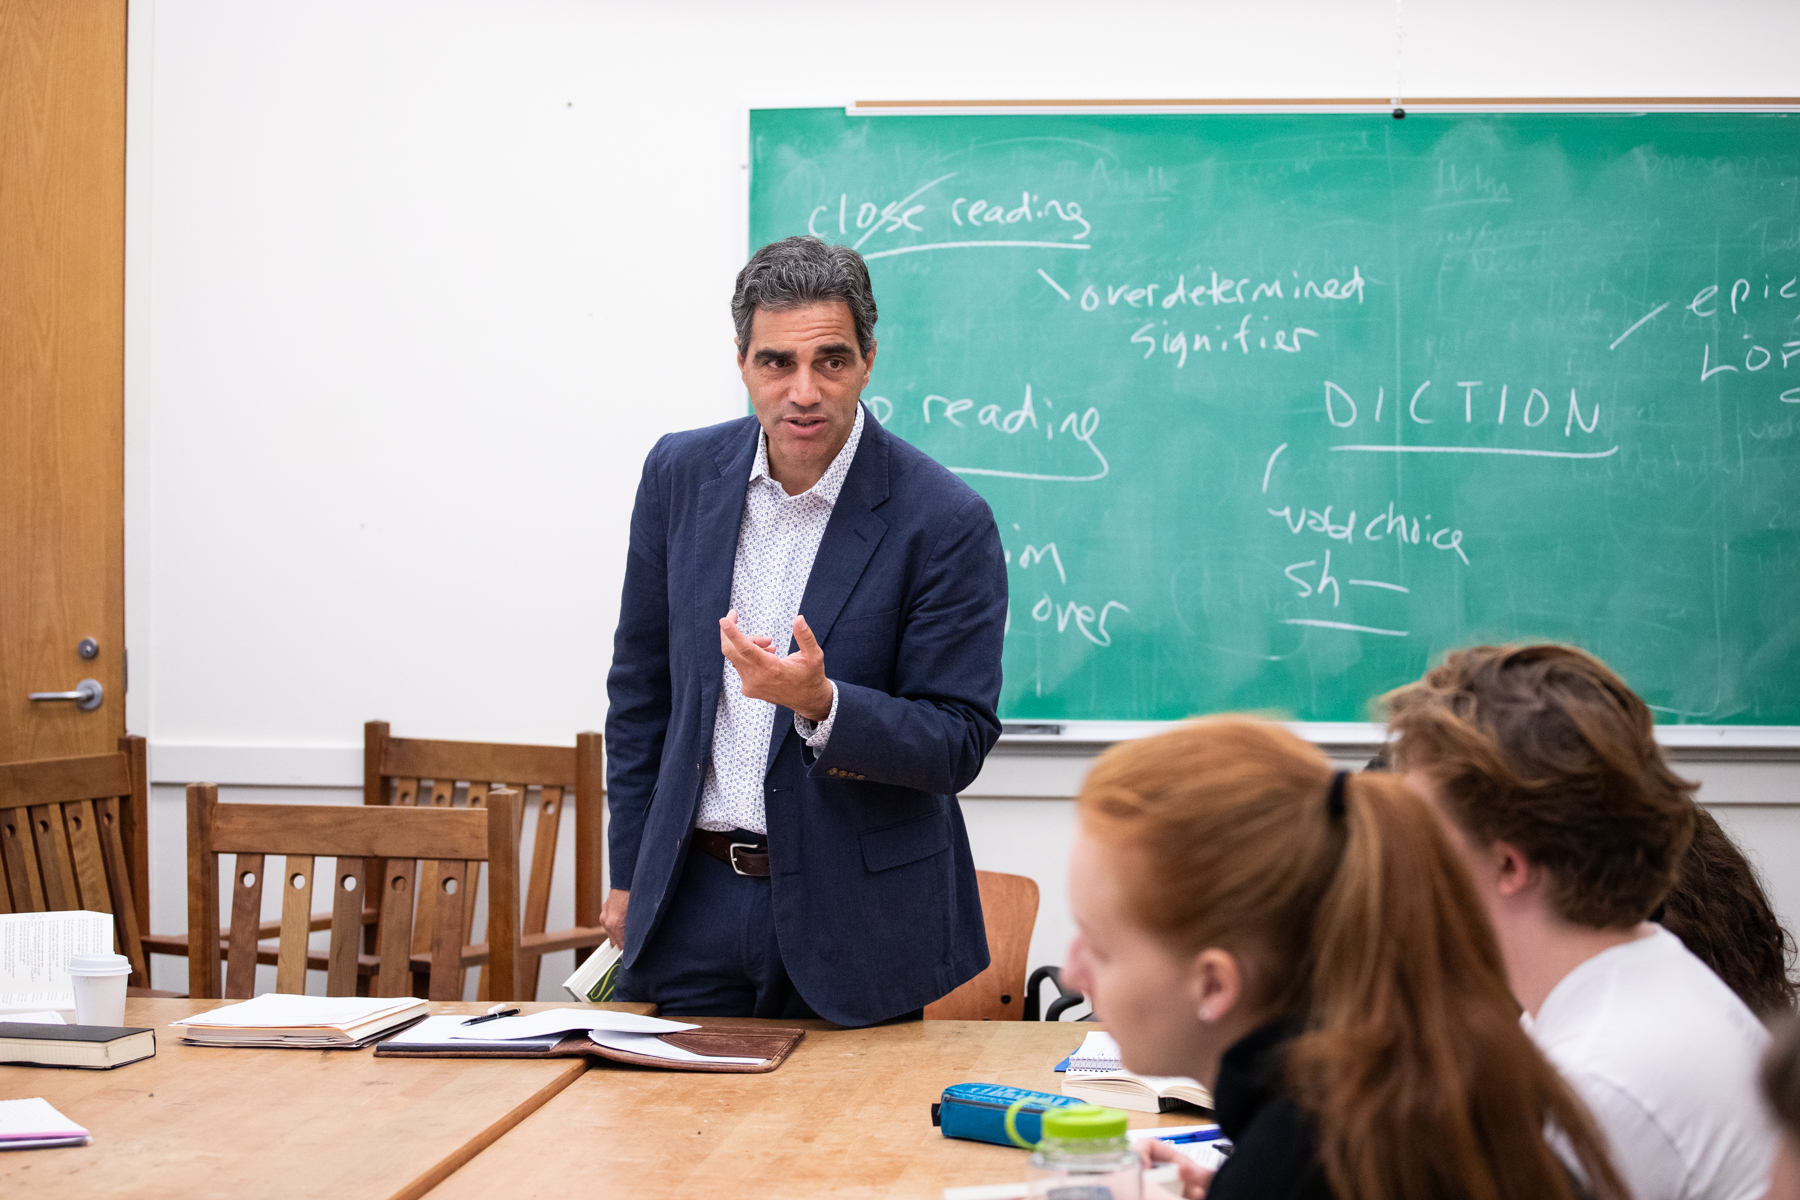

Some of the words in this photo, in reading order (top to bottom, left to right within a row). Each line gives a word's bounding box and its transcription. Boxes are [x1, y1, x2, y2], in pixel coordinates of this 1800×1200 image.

[808, 192, 926, 238] close
[951, 190, 1092, 241] reading
[1080, 265, 1365, 311] overdetermined
[1686, 272, 1798, 317] epic
[1130, 313, 1319, 369] signifier
[922, 383, 1109, 479] reading
[1324, 380, 1600, 437] DICTION
[1032, 592, 1131, 647] over
